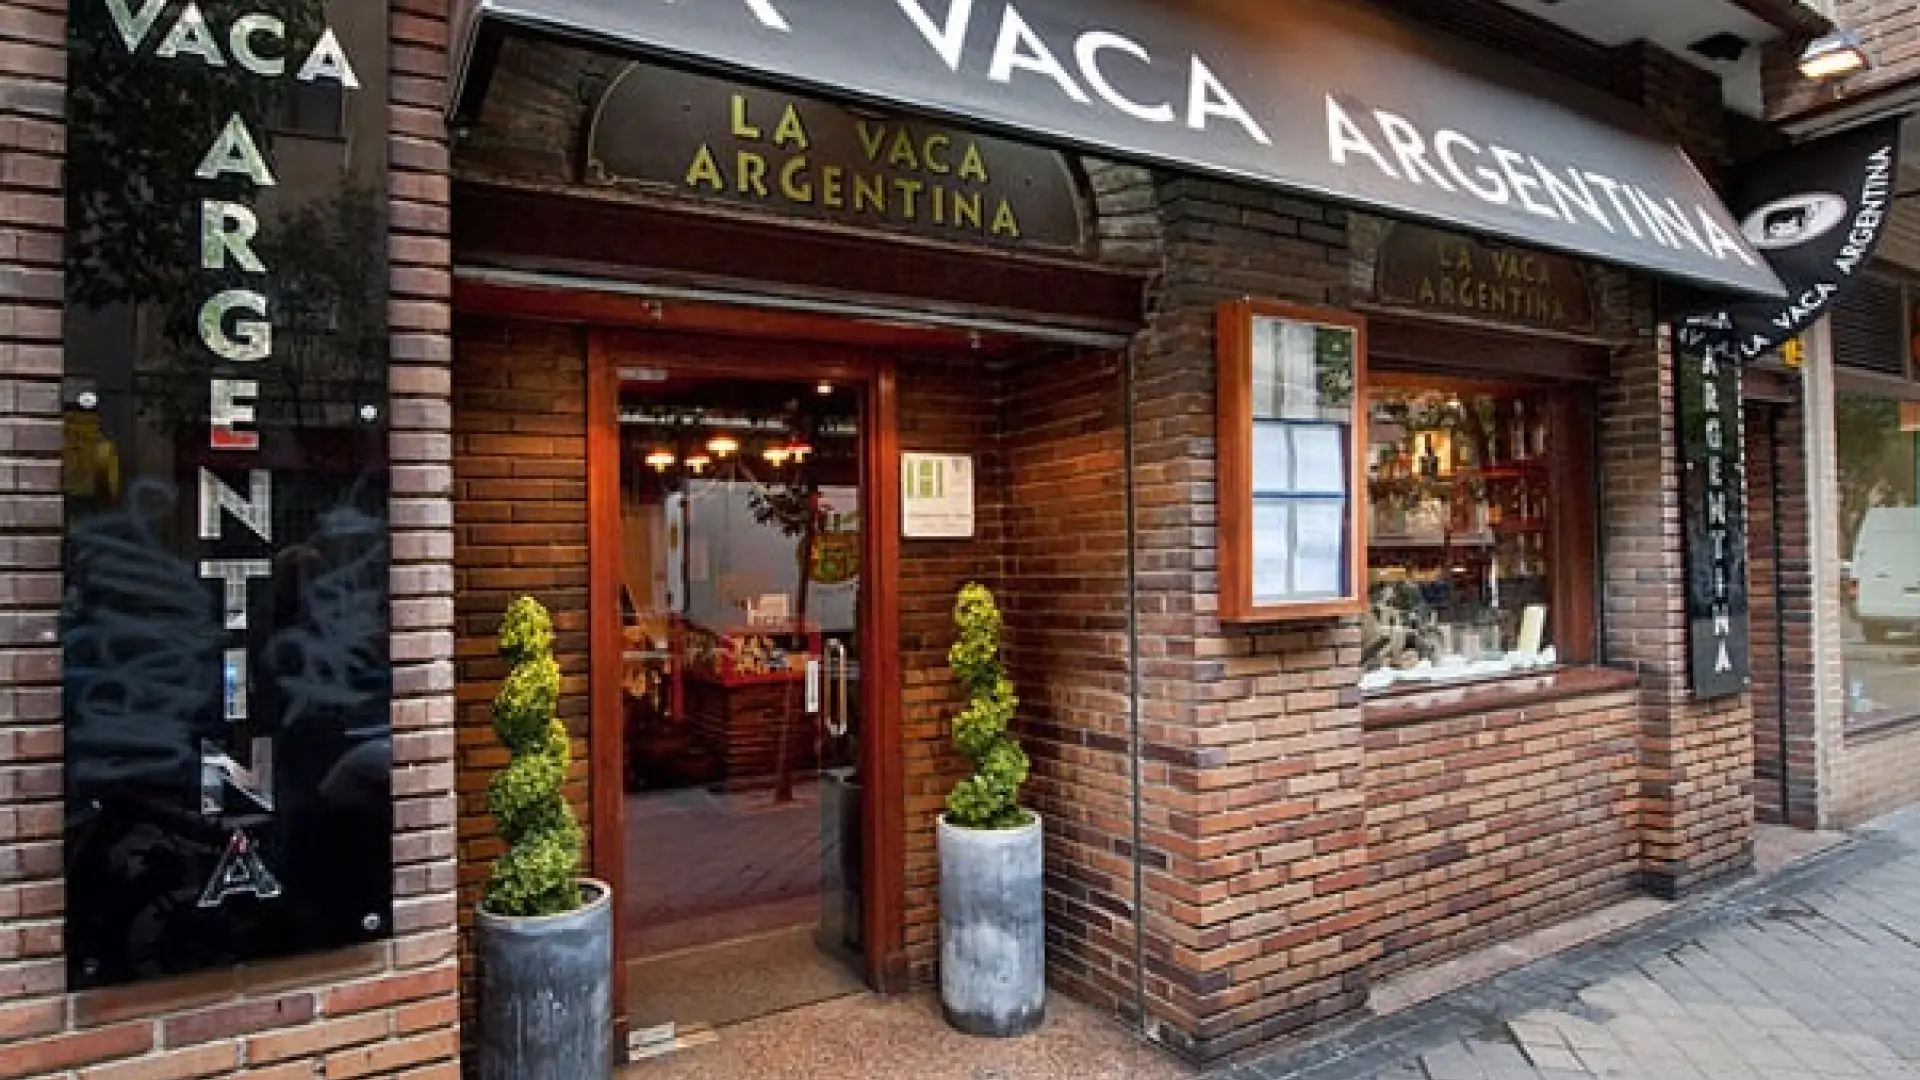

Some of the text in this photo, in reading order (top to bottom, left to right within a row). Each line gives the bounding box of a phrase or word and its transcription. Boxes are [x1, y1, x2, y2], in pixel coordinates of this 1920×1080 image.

[106, 0, 361, 90] VACA
[731, 94, 989, 184] LA VACA
[897, 0, 1757, 267] VACA ARGENTINA
[685, 142, 1021, 238] ARGENTINA
[1438, 243, 1550, 284] LA VACA
[1741, 145, 1892, 356] LA VACA ARGENTINA
[1420, 276, 1566, 325] ARGENTINA
[194, 110, 281, 908] ARGENTINA
[1701, 345, 1733, 674] ARGENTINA
